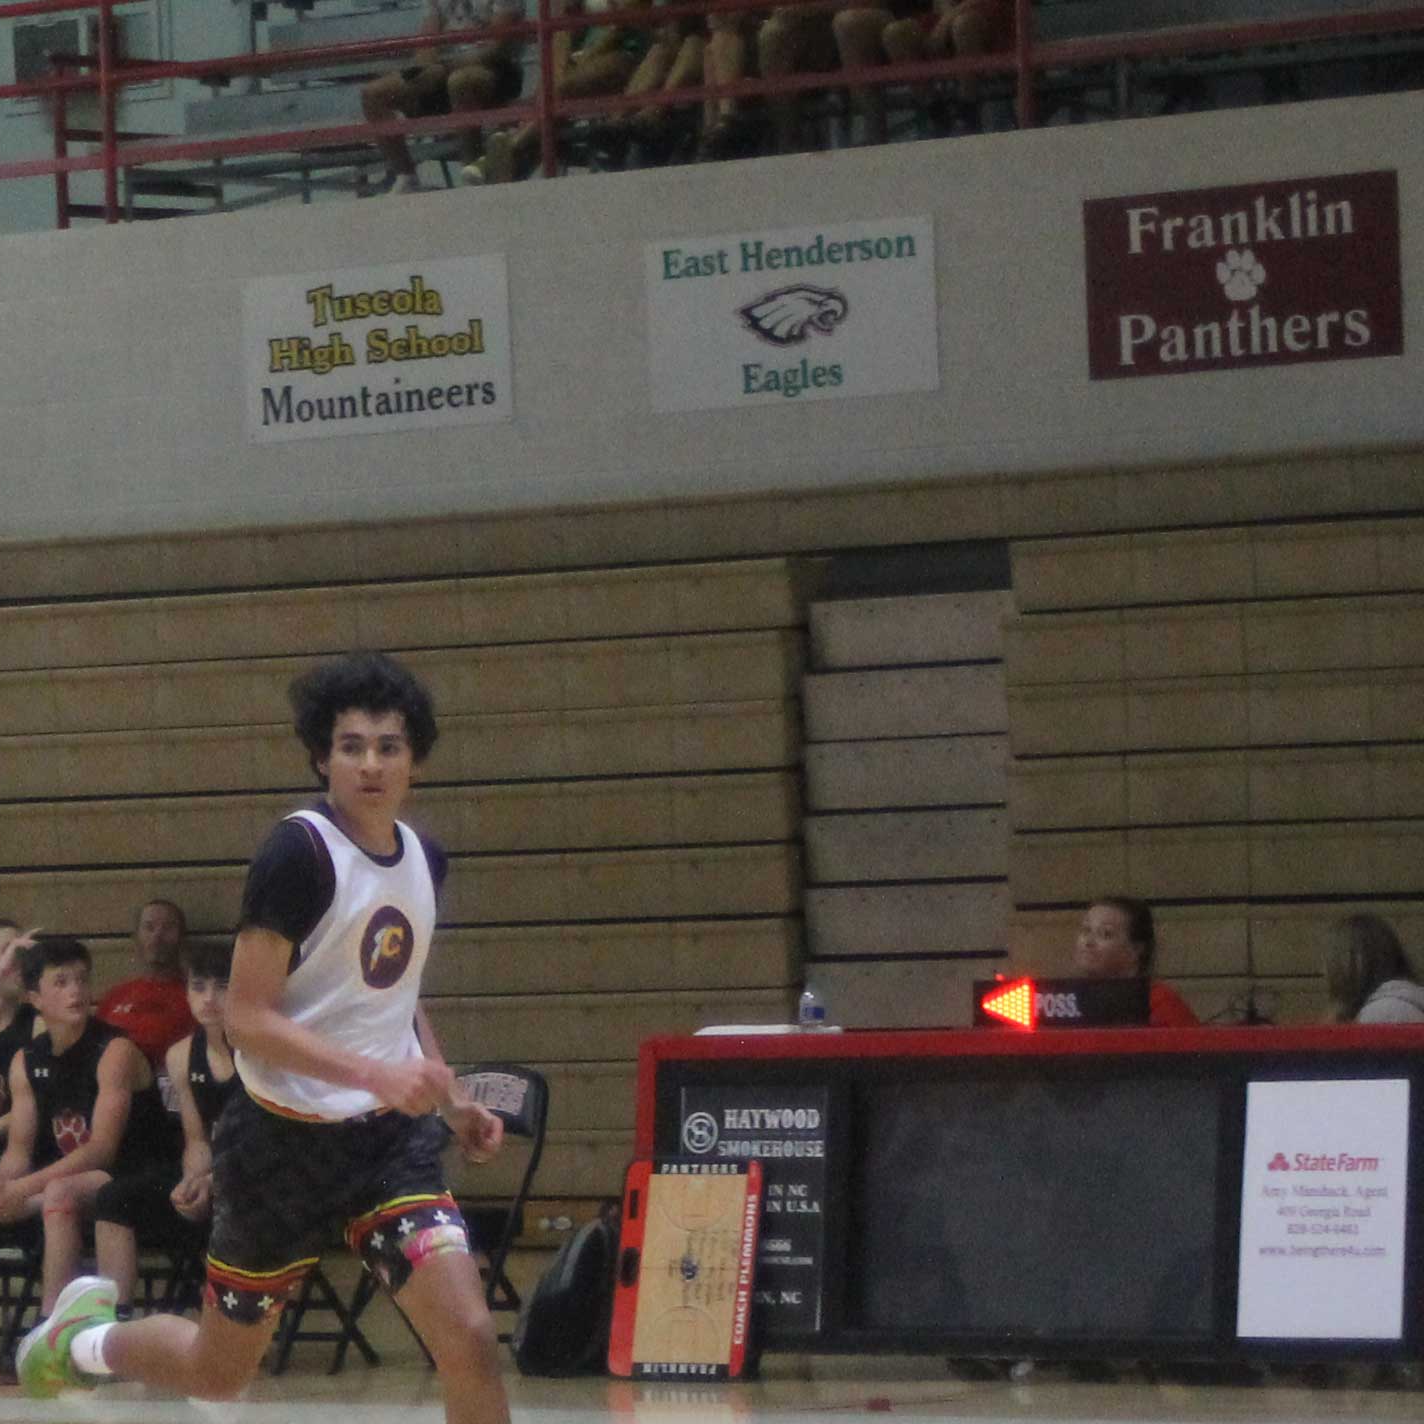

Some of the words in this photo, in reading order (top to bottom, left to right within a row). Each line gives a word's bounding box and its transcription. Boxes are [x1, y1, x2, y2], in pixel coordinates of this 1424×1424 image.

[1125, 189, 1354, 255] Franklin
[661, 248, 730, 280] East
[738, 233, 917, 273] Henderson
[306, 275, 444, 328] Tuscola
[269, 331, 356, 375] High
[365, 318, 486, 364] School
[1118, 303, 1372, 367] Panthers
[261, 376, 498, 426] Mountaineers
[741, 358, 845, 398] Eagles
[1035, 992, 1082, 1018] POSS.
[723, 1108, 822, 1130] HAYWOOD
[660, 1163, 739, 1175] PANTHERS
[717, 1139, 825, 1158] SMOKEHOUSE
[788, 1184, 808, 1198] NC
[738, 1193, 759, 1286] PLEMMONS
[733, 1288, 748, 1346] COACH
[780, 1290, 803, 1305] NC
